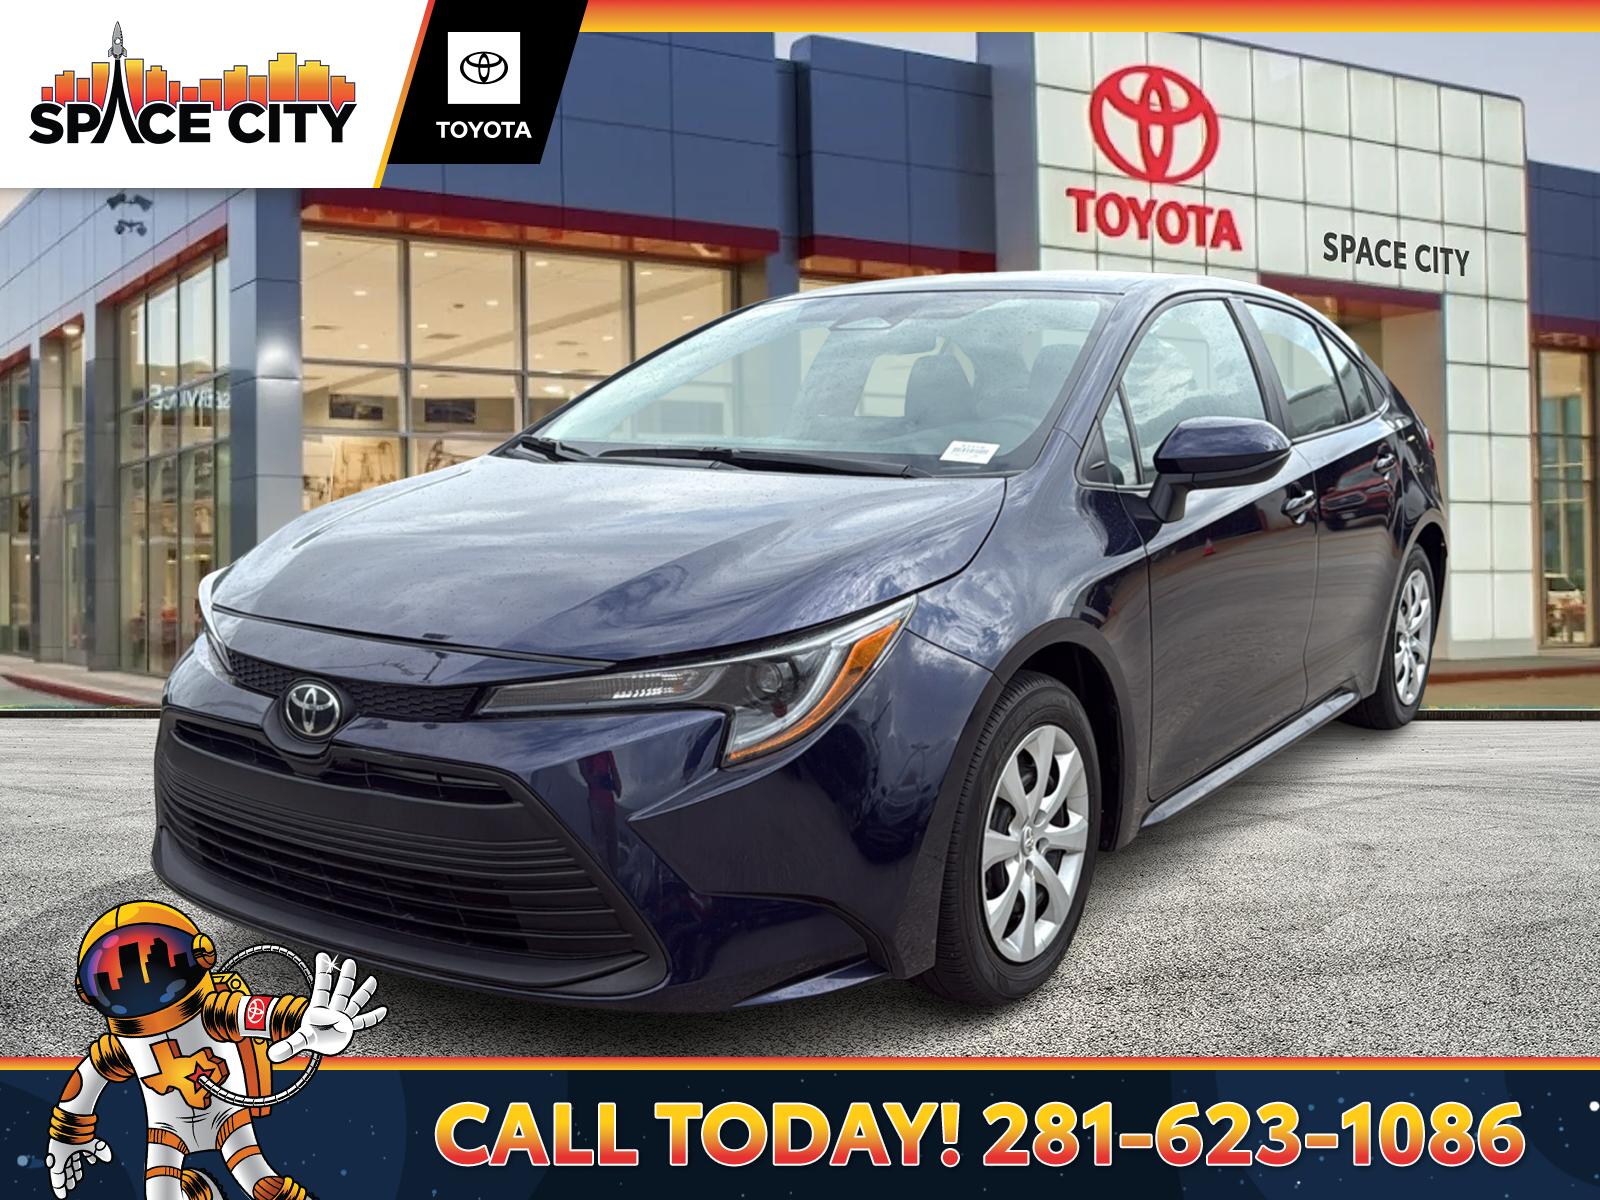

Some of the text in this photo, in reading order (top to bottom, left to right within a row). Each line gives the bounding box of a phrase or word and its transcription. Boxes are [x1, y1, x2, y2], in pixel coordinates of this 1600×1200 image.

[1066, 188, 1242, 251] TOYOTA
[1323, 232, 1470, 277] SPACE CITY
